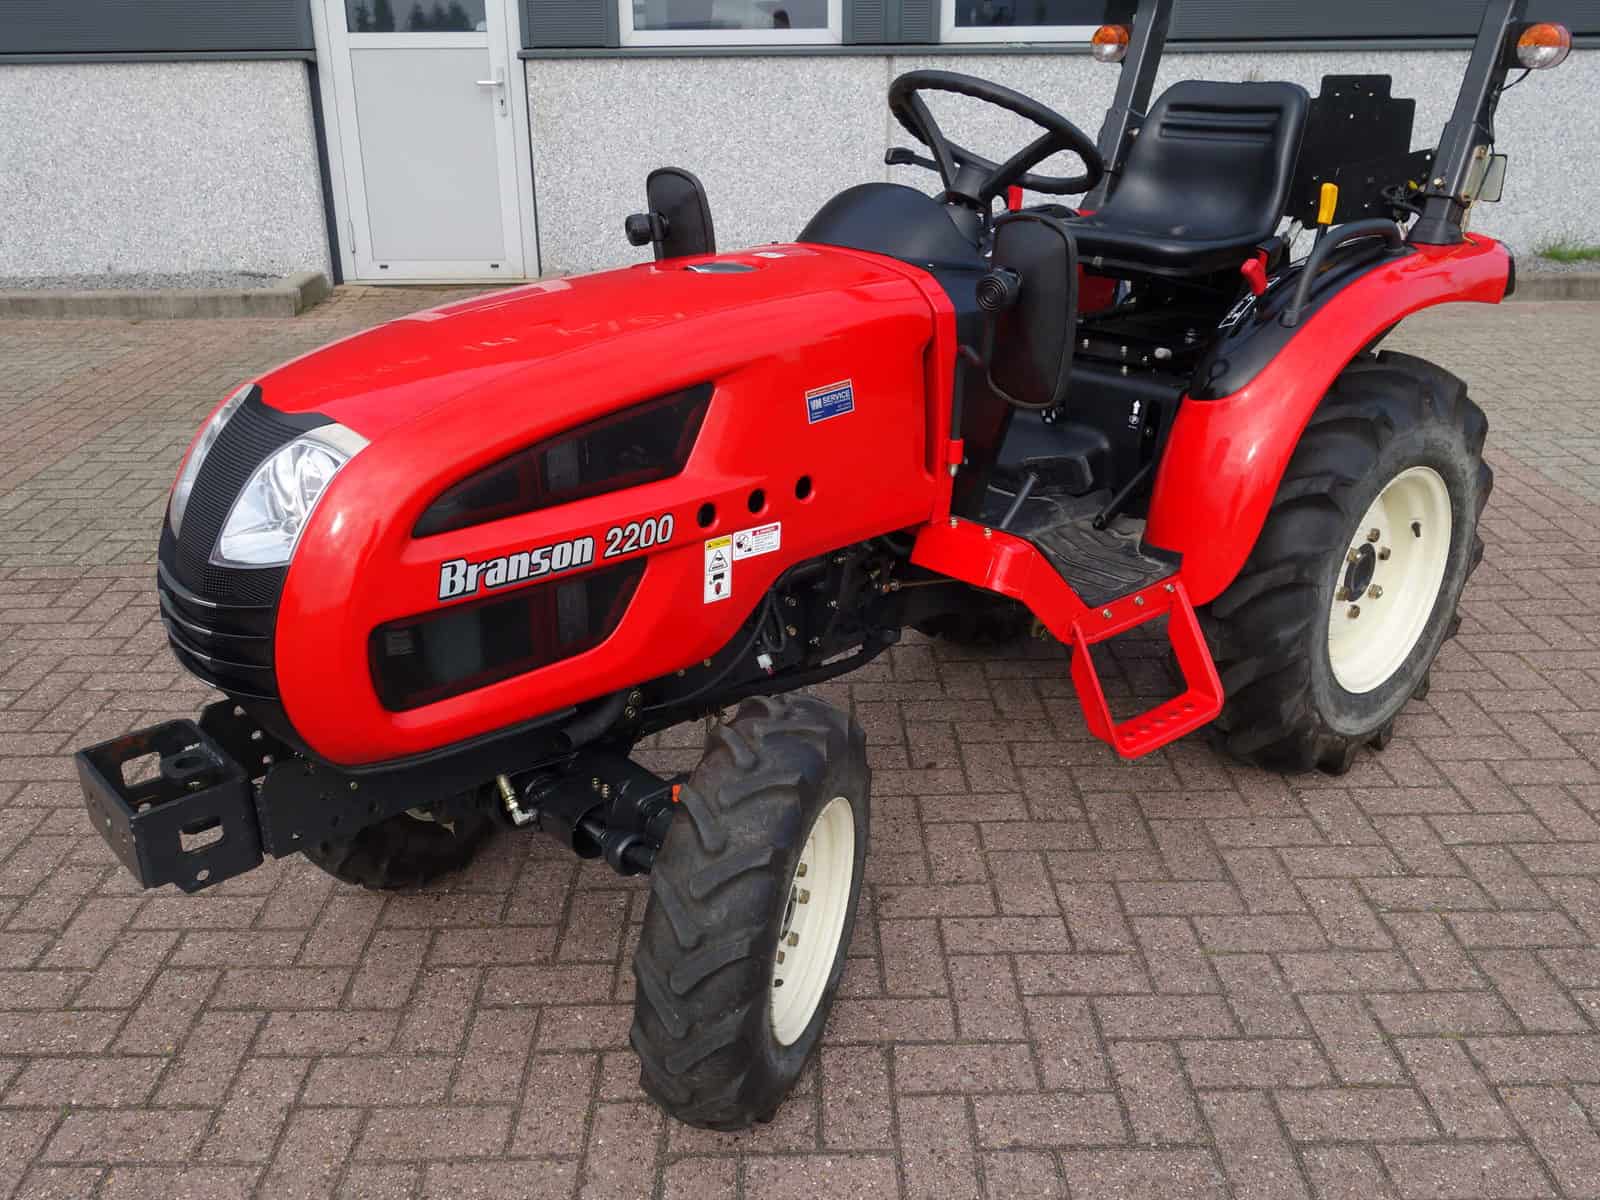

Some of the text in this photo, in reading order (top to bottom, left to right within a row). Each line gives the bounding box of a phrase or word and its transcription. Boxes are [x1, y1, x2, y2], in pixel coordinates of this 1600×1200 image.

[823, 390, 850, 404] SERVICE
[439, 514, 674, 600] Branson 2200
